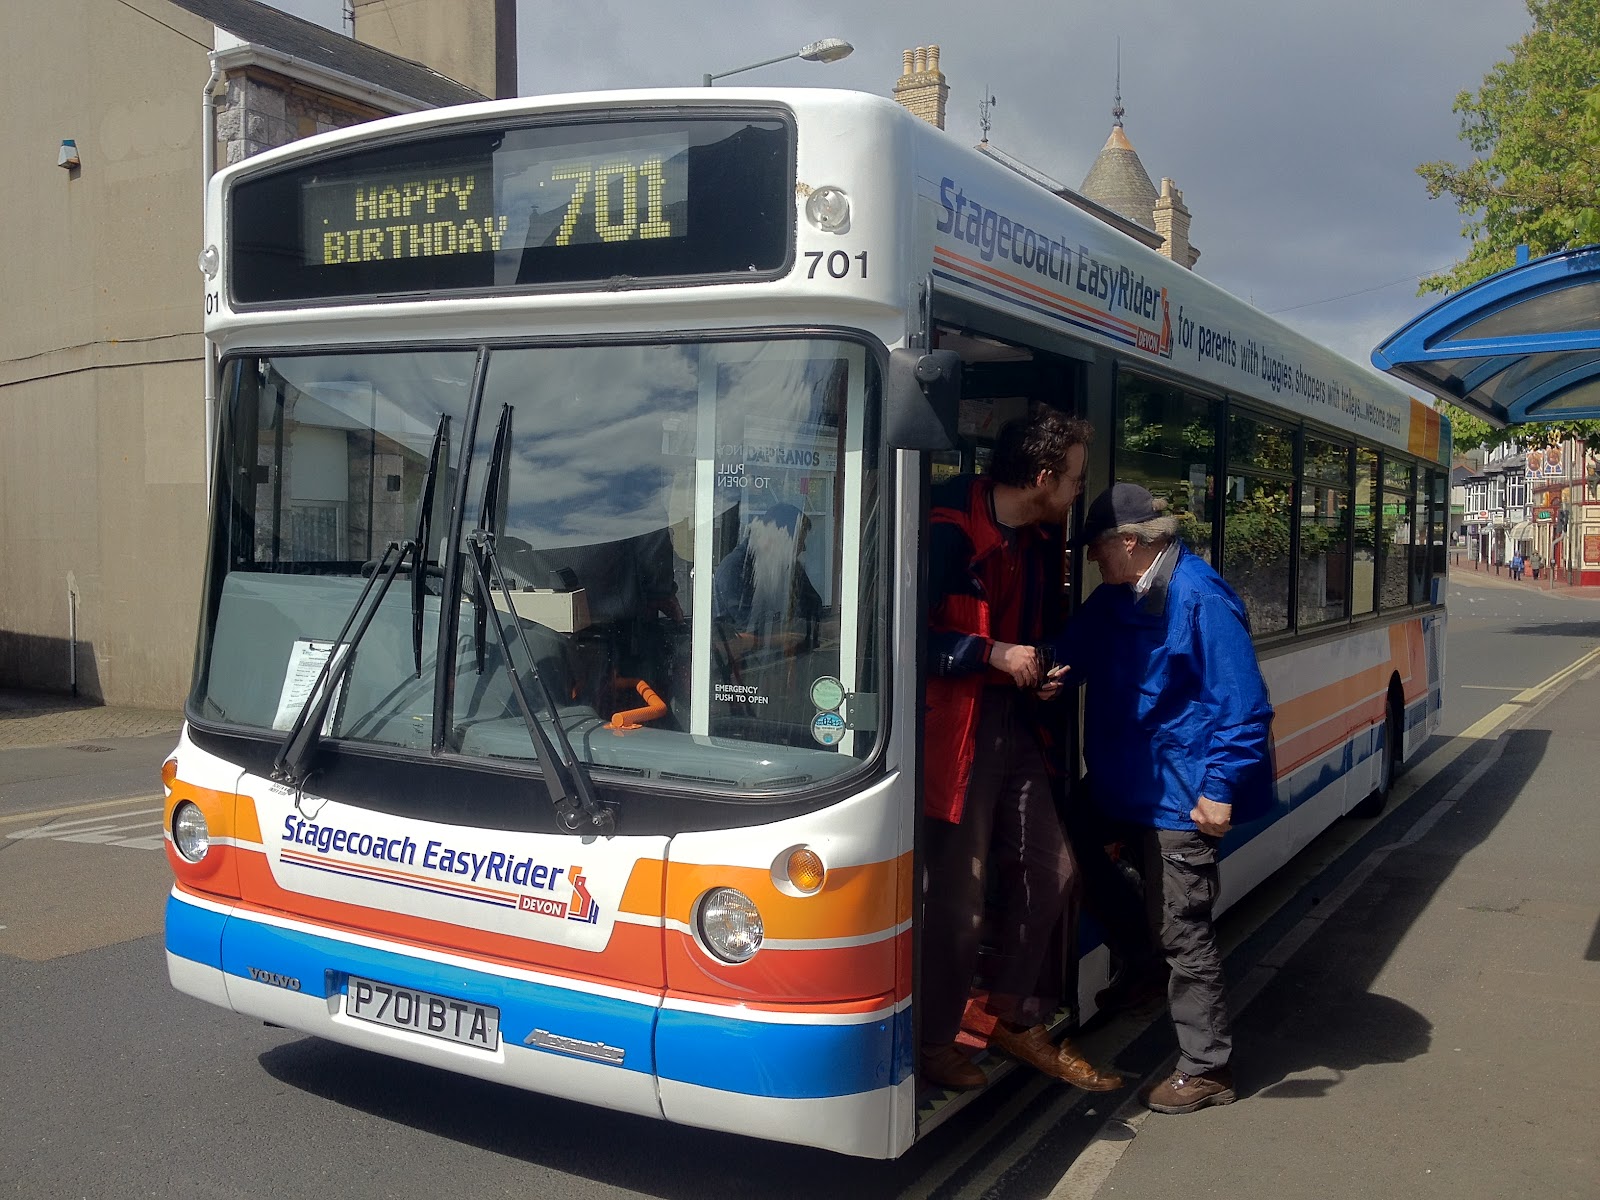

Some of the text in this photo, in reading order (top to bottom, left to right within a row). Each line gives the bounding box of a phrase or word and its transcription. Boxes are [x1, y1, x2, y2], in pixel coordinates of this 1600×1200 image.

[355, 175, 475, 221] HAPPY
[551, 153, 673, 246] 701
[323, 215, 508, 265] BIRTHDAY
[936, 176, 1161, 322] Stagecoach EasyRider
[804, 249, 869, 280] 701
[204, 291, 219, 316] 01
[1138, 330, 1159, 352] DEVON
[1178, 305, 1195, 349] for
[1198, 325, 1237, 368] parents
[1240, 335, 1259, 377] with
[1295, 364, 1326, 406] shoppers
[714, 684, 759, 694] EMERGENCY
[714, 693, 769, 705] PUSH TO OPEN
[281, 814, 565, 891] Stagecoach EasyRider
[522, 897, 562, 916] DEVON
[247, 965, 301, 991] VOLVO
